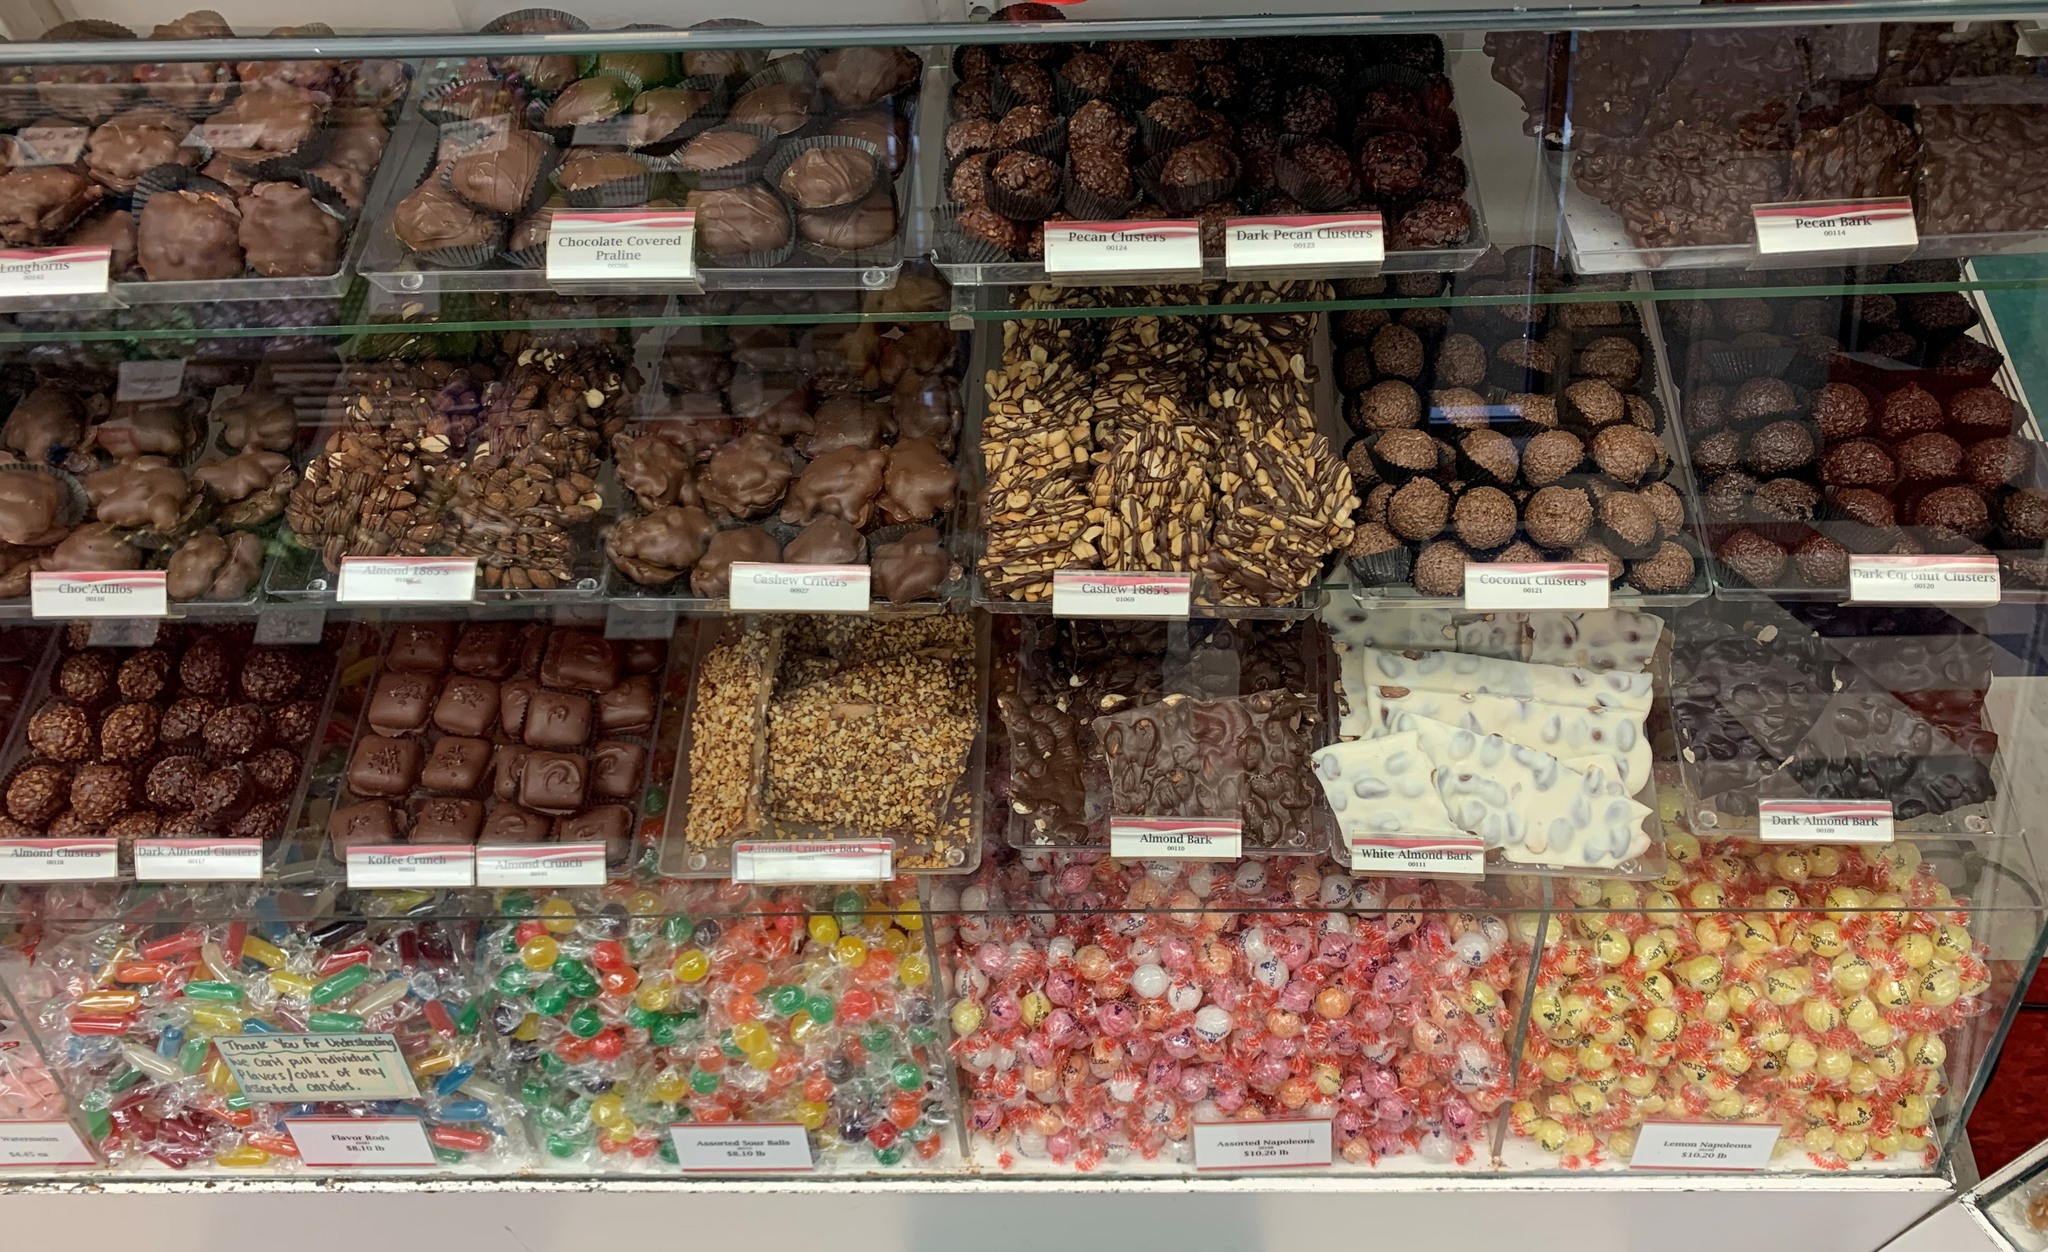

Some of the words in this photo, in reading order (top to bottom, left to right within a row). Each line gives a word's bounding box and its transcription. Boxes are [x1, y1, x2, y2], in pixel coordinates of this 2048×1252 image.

[1795, 218, 1836, 229] Pecan
[1839, 215, 1872, 228] Bark
[1068, 231, 1107, 243] Pecan
[1111, 231, 1166, 243] Clusters
[1236, 230, 1269, 242] Dark
[1272, 229, 1313, 241] Pecan
[1316, 227, 1373, 240] Clusters
[558, 237, 623, 247] Chocolate
[626, 235, 681, 247] Covered
[595, 250, 642, 261] Praline
[0, 262, 70, 274] Longhorns
[362, 565, 408, 575] Almond
[1853, 569, 1883, 579] Dark
[1943, 572, 1996, 582] Clusters
[753, 574, 797, 585] Cashew
[802, 575, 848, 587] Critters
[1479, 574, 1532, 585] Coconut
[1535, 575, 1586, 586] Clusters
[58, 583, 132, 595] Choc'Adillos
[1081, 583, 1127, 594] Cashew
[1131, 584, 1170, 596] 1885's
[1772, 816, 1800, 826] Dark
[1803, 816, 1849, 827] Almond
[1852, 817, 1879, 827] Bark
[1139, 833, 1184, 844] Almond
[1187, 834, 1213, 845] Bark
[10, 848, 53, 857] Almond
[56, 848, 101, 857] Clusters
[138, 847, 164, 856] Dark
[167, 847, 210, 856] Almond
[213, 848, 258, 856] Clusters
[749, 845, 790, 853] Almond
[796, 844, 836, 853] Crunch
[840, 844, 864, 853] Bark
[1361, 848, 1394, 859] White
[1398, 849, 1443, 860] Almond
[1446, 850, 1473, 861] Bark
[368, 856, 403, 864] Koffee
[406, 855, 446, 864] Crunch
[495, 859, 539, 870] Almond
[542, 858, 583, 869] Crunch
[222, 1039, 268, 1051] Thank
[274, 1038, 299, 1050] You
[326, 1036, 398, 1052] Understanding
[289, 1057, 312, 1069] pull
[317, 1053, 380, 1064] individual
[337, 1067, 351, 1077] of
[358, 1067, 387, 1079] any
[244, 1083, 299, 1093] assorted
[1216, 1139, 1260, 1147] Assorted
[1263, 1138, 1315, 1146] Napoleons
[1700, 1141, 1752, 1149] Napoleons
